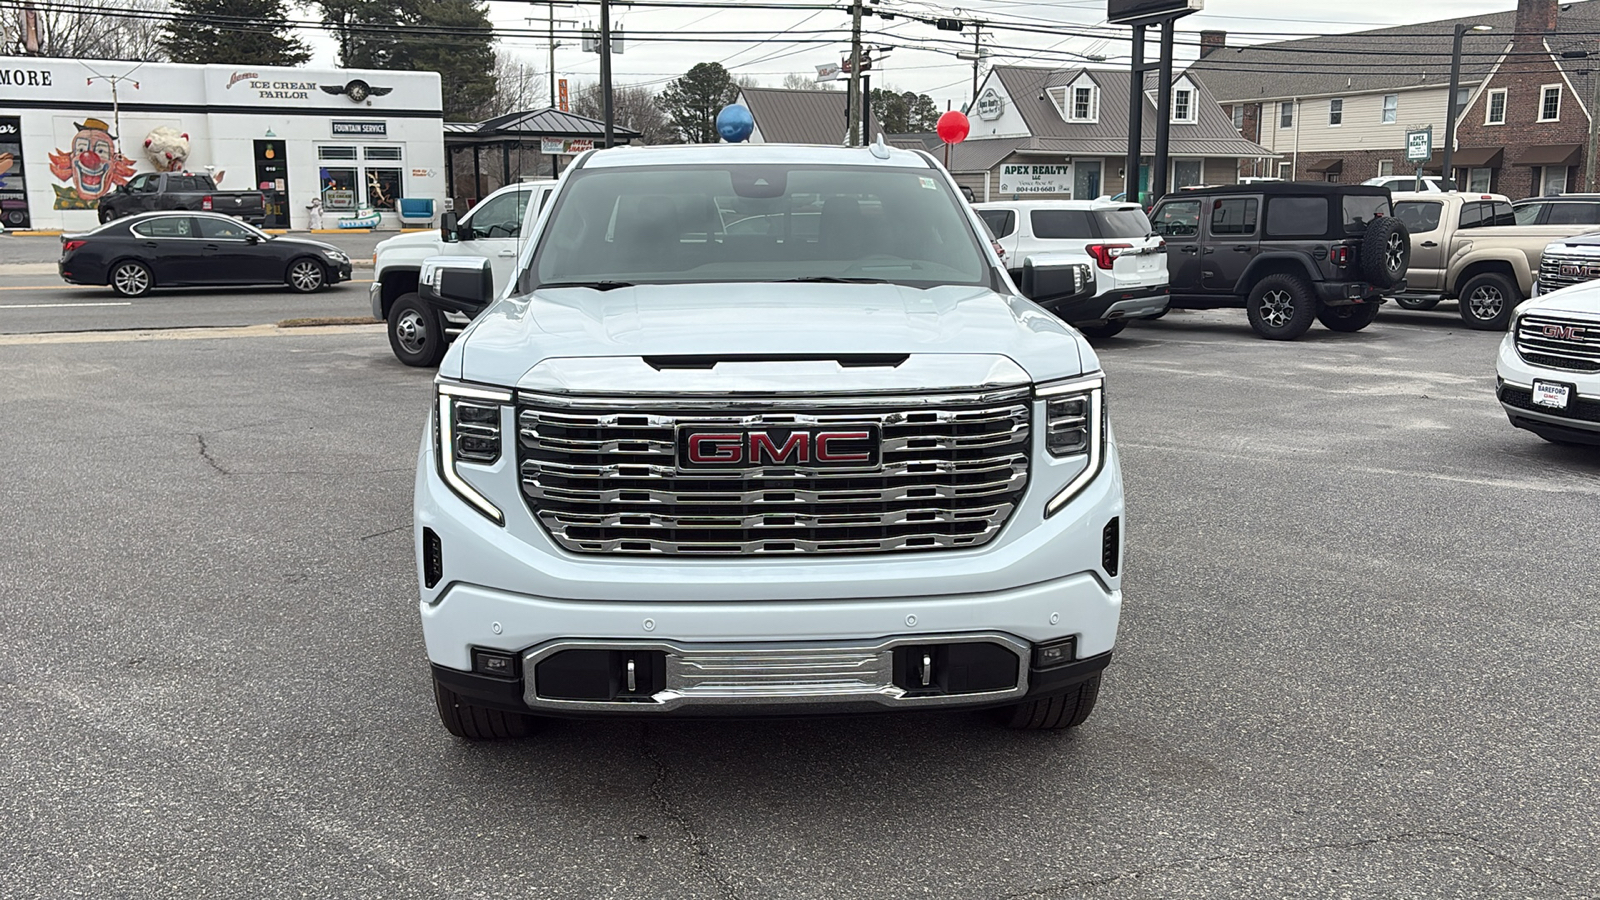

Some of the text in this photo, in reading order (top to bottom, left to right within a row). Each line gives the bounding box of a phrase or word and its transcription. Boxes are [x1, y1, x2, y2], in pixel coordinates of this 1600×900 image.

[0, 69, 52, 86] MORE
[250, 81, 317, 90] ICE CREAM
[259, 90, 309, 99] PARLOR
[333, 123, 385, 133] FOUNTAIN SERVICE
[1004, 165, 1068, 175] APEX REALTY
[1560, 265, 1600, 278] GMC
[1542, 324, 1586, 340] GMC
[1537, 385, 1567, 396] BAREFORD
[688, 431, 870, 464] GMC
